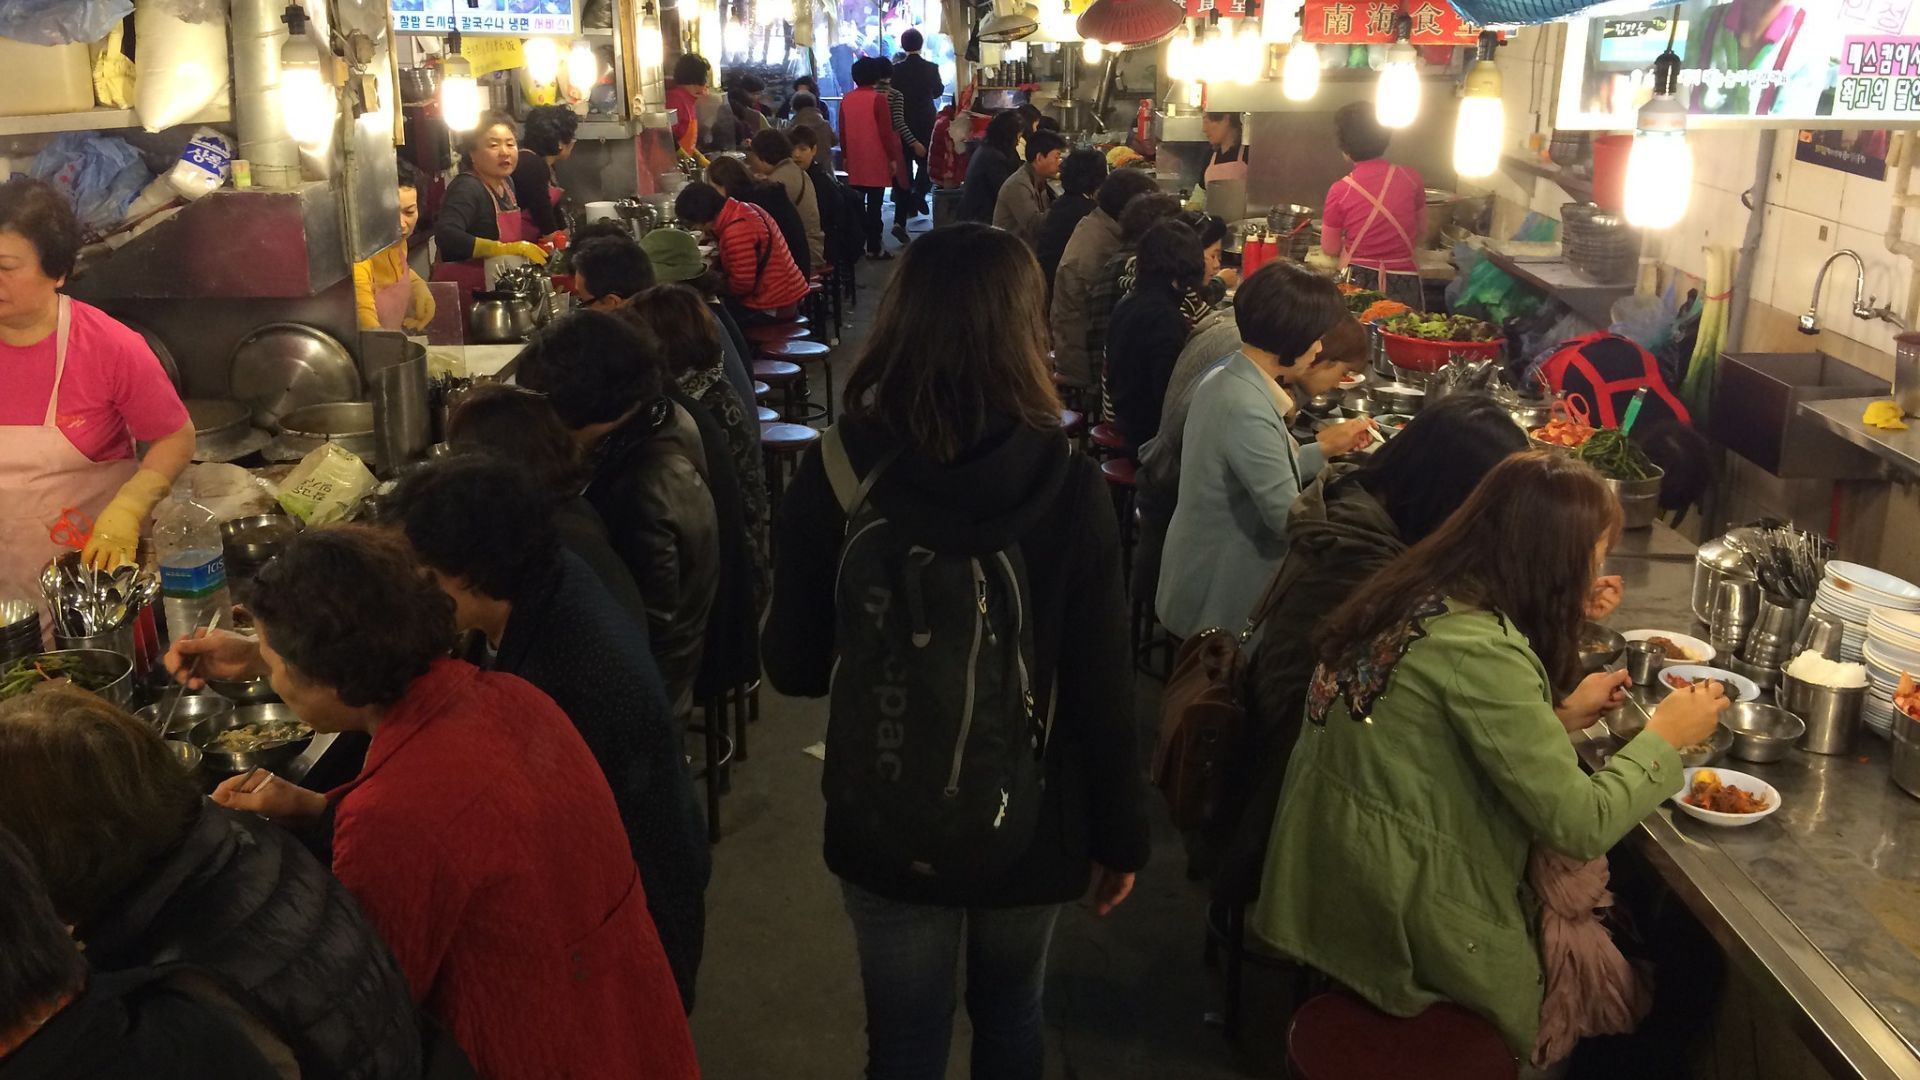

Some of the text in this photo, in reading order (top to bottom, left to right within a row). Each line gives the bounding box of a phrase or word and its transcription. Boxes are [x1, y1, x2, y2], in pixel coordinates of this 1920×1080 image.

[461, 16, 504, 30] 칼국수나
[509, 17, 529, 31] 냉면
[1840, 77, 1889, 111] 최고의
